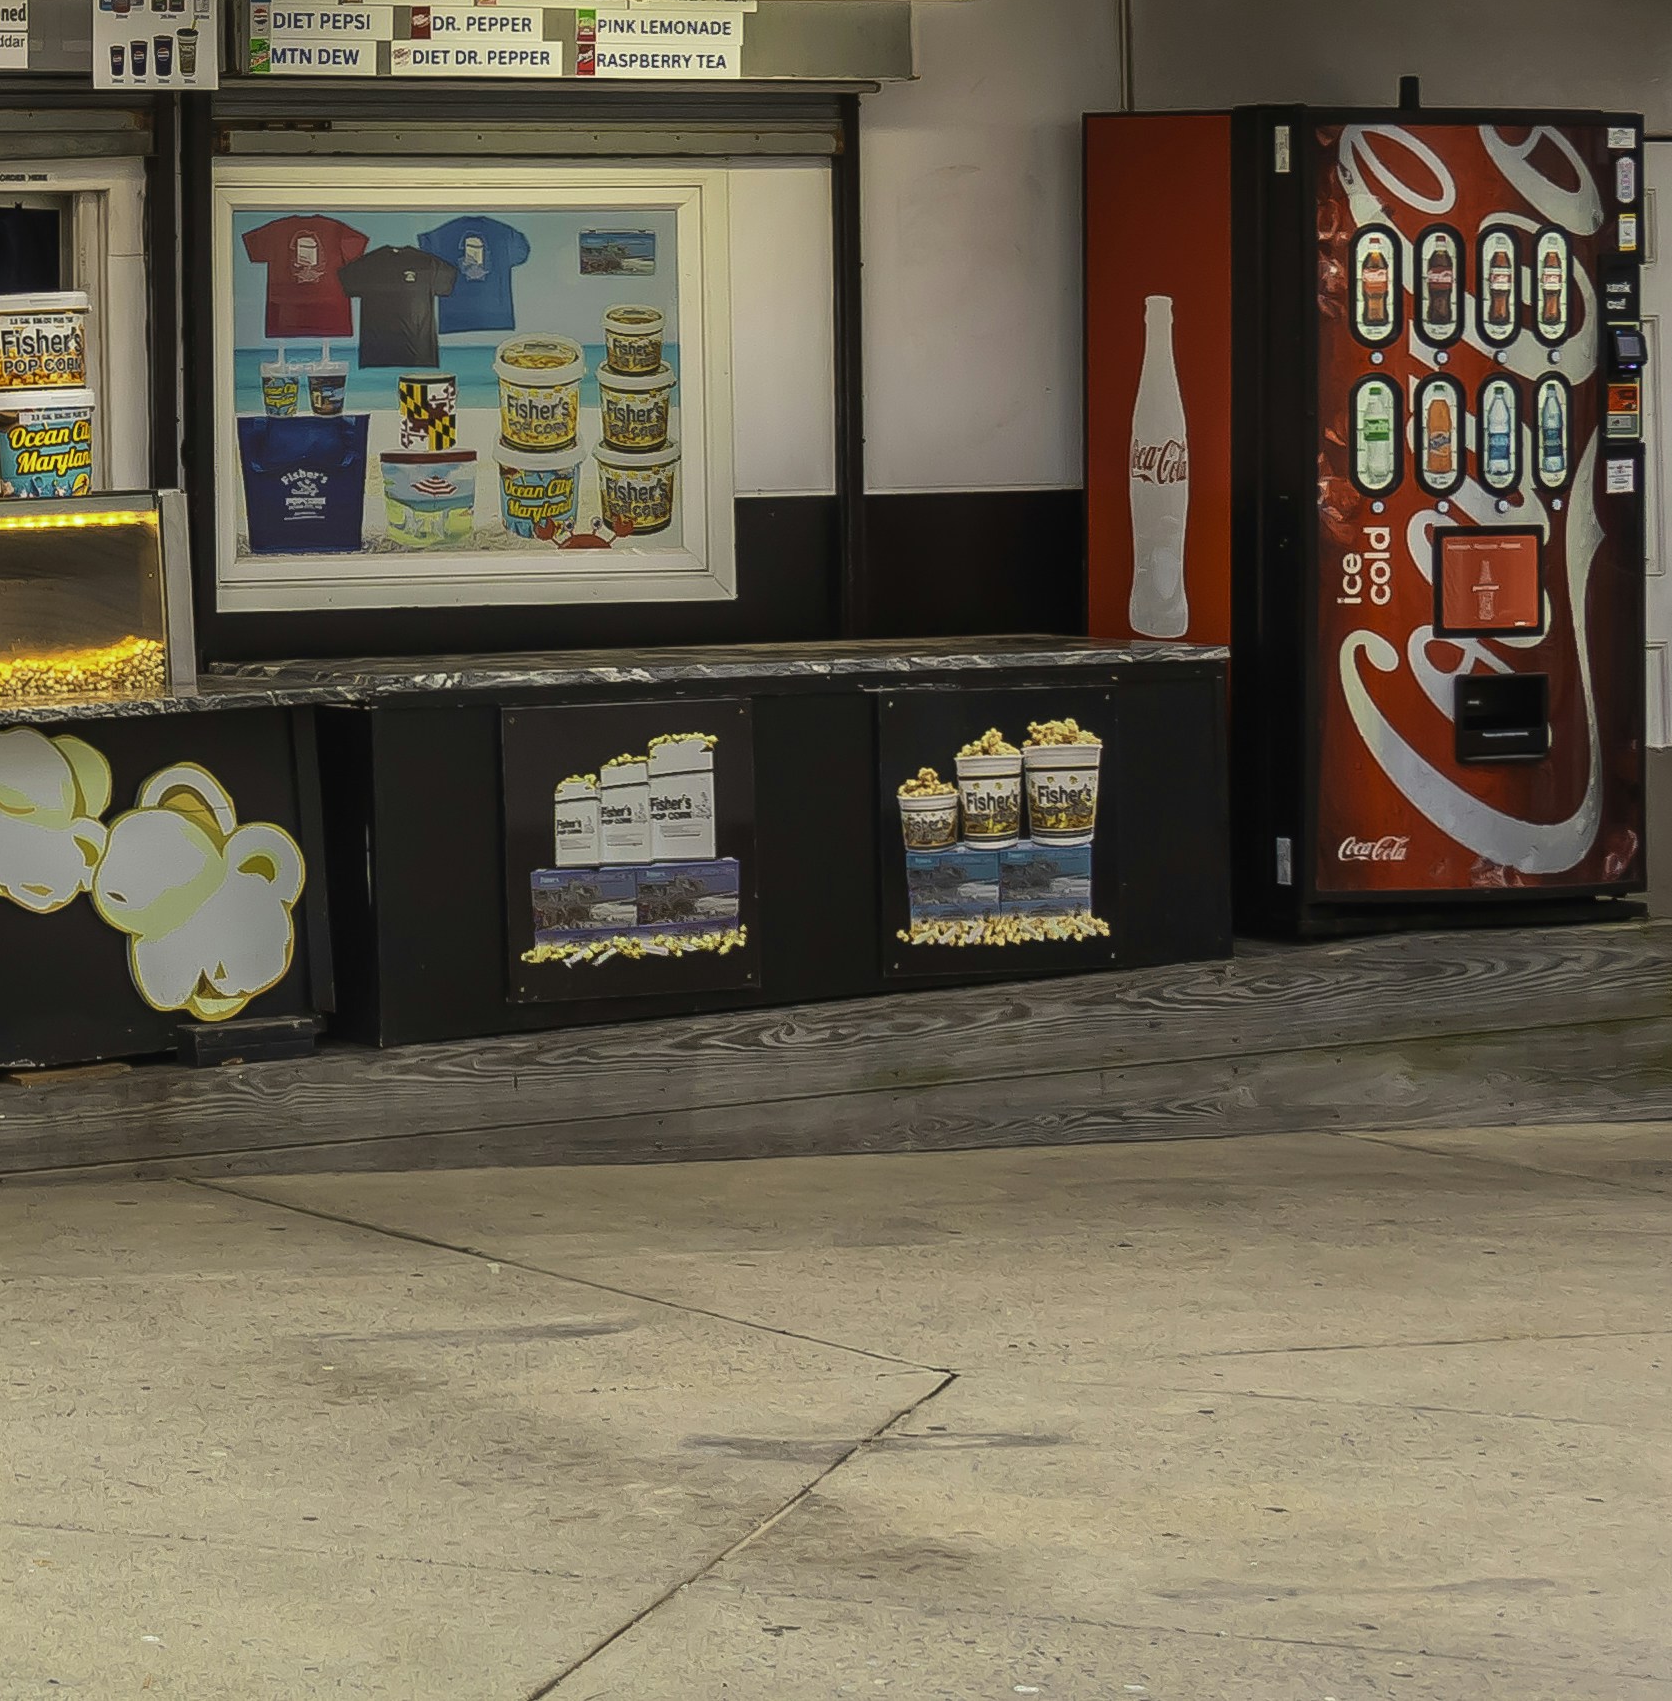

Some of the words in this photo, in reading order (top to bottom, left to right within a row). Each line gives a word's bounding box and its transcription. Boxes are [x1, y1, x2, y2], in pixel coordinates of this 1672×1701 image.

[273, 13, 314, 28] DIET
[320, 14, 370, 29] PEPSI
[433, 16, 460, 31] DR.
[467, 16, 532, 32] PEPPER
[598, 20, 635, 34] PINK
[641, 20, 731, 35] LEMONADE
[272, 49, 312, 63] MTN
[318, 49, 359, 65] DEW
[413, 50, 450, 64] DIET
[455, 51, 482, 65] DR.
[488, 51, 550, 65] PEPPER
[597, 54, 691, 68] RASPBERRY
[696, 55, 726, 69] TEA
[1, 327, 82, 355] Fisher's
[4, 359, 38, 373] POP
[507, 395, 570, 420] Fisher's
[606, 399, 663, 422] Fisher's
[10, 426, 69, 449] Ocean
[281, 469, 328, 485] Fisher's
[505, 478, 543, 498] Ocean
[606, 477, 667, 501] Fisher's
[508, 498, 571, 522] Maryland
[1363, 526, 1391, 606] cold
[1337, 553, 1362, 604] ice
[650, 794, 692, 811] Fisher's
[966, 791, 1018, 814] Fisher's
[1037, 784, 1092, 805] Fisher's
